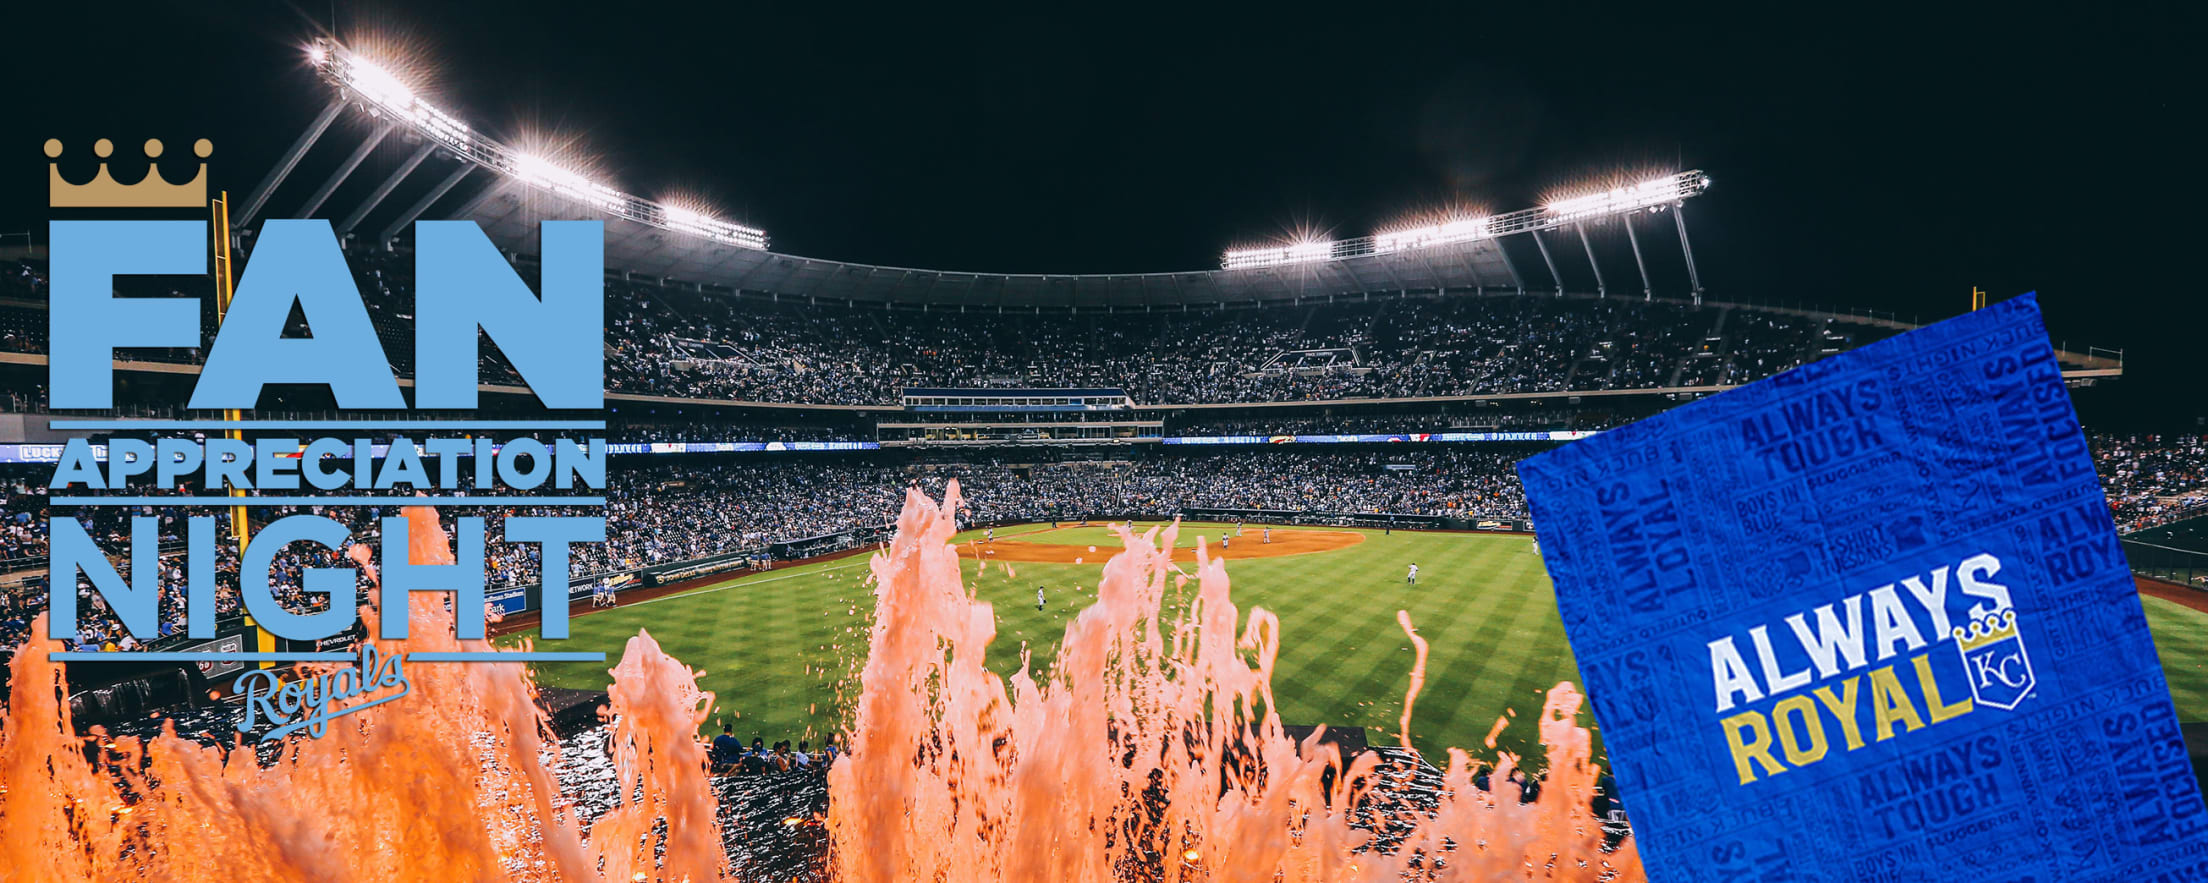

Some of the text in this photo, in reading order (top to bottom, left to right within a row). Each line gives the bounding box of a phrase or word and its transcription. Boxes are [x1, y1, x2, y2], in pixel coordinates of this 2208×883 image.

[1736, 377, 1883, 450] ALWAYS
[1755, 414, 1883, 482] TOUGH
[1982, 353, 2057, 492] ALWAYS
[2019, 341, 2092, 481] FOCUSED
[1594, 480, 1666, 618] ALWAYS
[1632, 478, 1699, 597] LOYAL
[1736, 491, 1778, 518] BOYS
[2045, 535, 2124, 587] ROY
[1707, 553, 2014, 713] ALWAYS
[1971, 650, 2026, 689] KC
[1720, 653, 1974, 785] ROYAL
[1854, 734, 2004, 809] ALWAYS
[1874, 773, 2002, 841] TOUGH
[2101, 710, 2174, 849] ALWAYS
[2138, 699, 2207, 837] FOCUSED
[1854, 850, 1897, 878] BOYS
